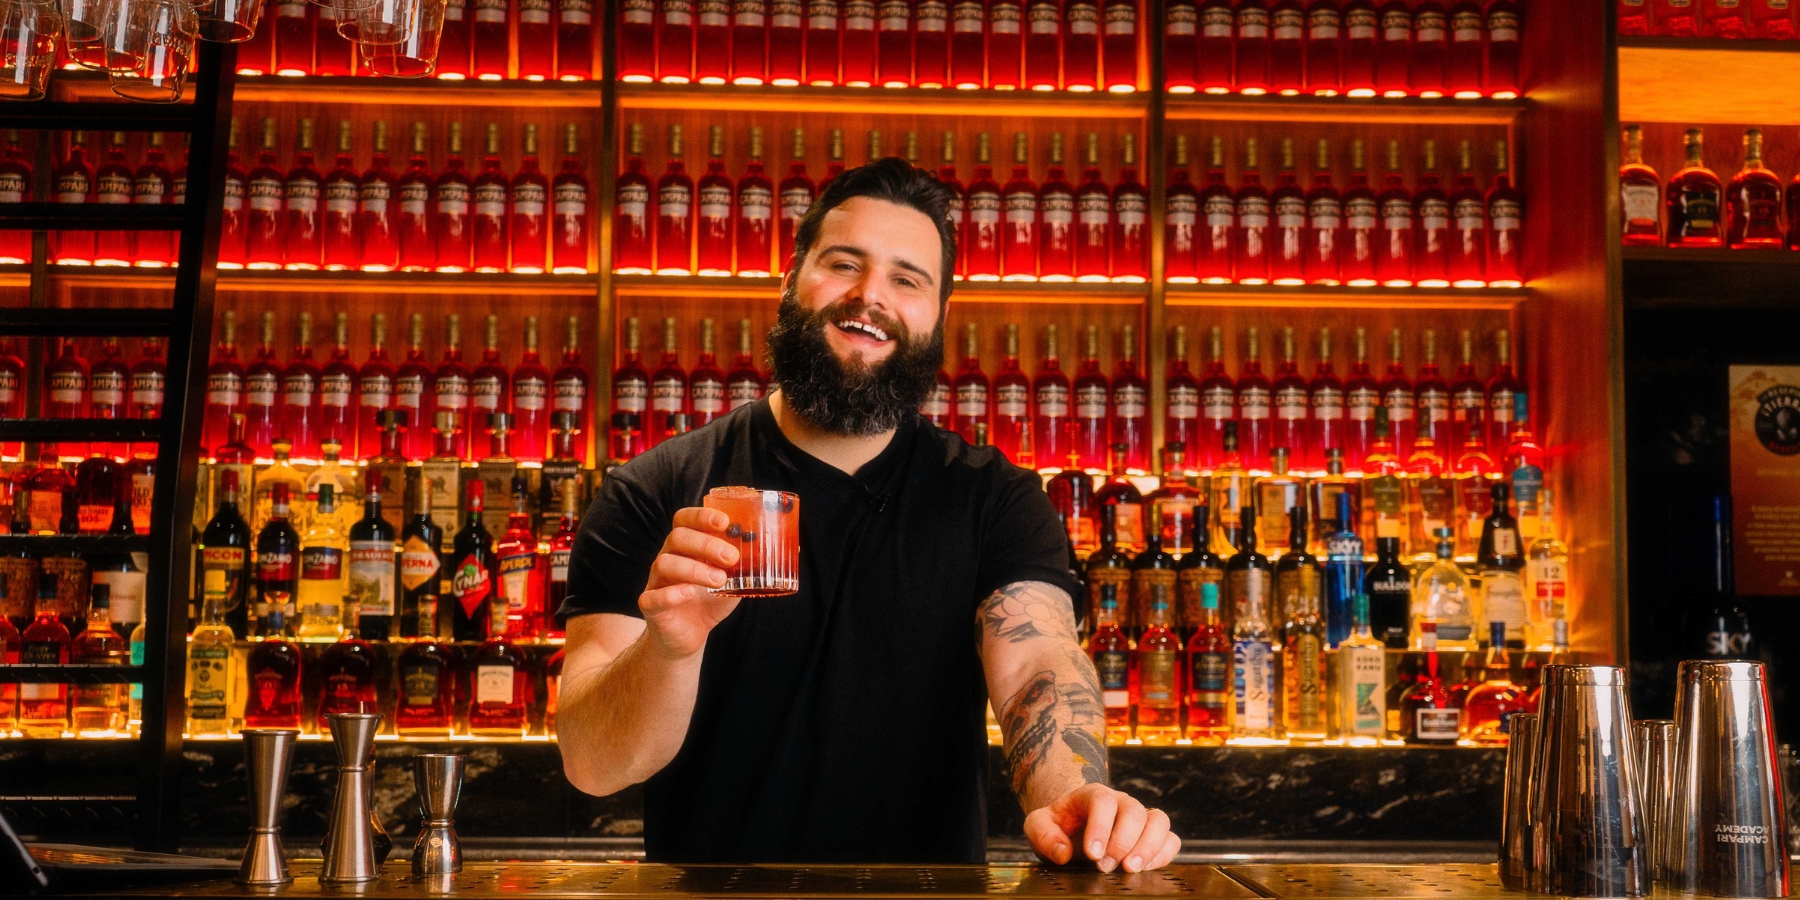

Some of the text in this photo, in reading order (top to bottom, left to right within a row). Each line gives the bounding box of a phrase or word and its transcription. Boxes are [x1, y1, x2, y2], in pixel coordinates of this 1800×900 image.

[500, 556, 534, 573] APEROL
[1715, 824, 1771, 834] ACADEMY
[1717, 834, 1768, 844] CAMPARI
